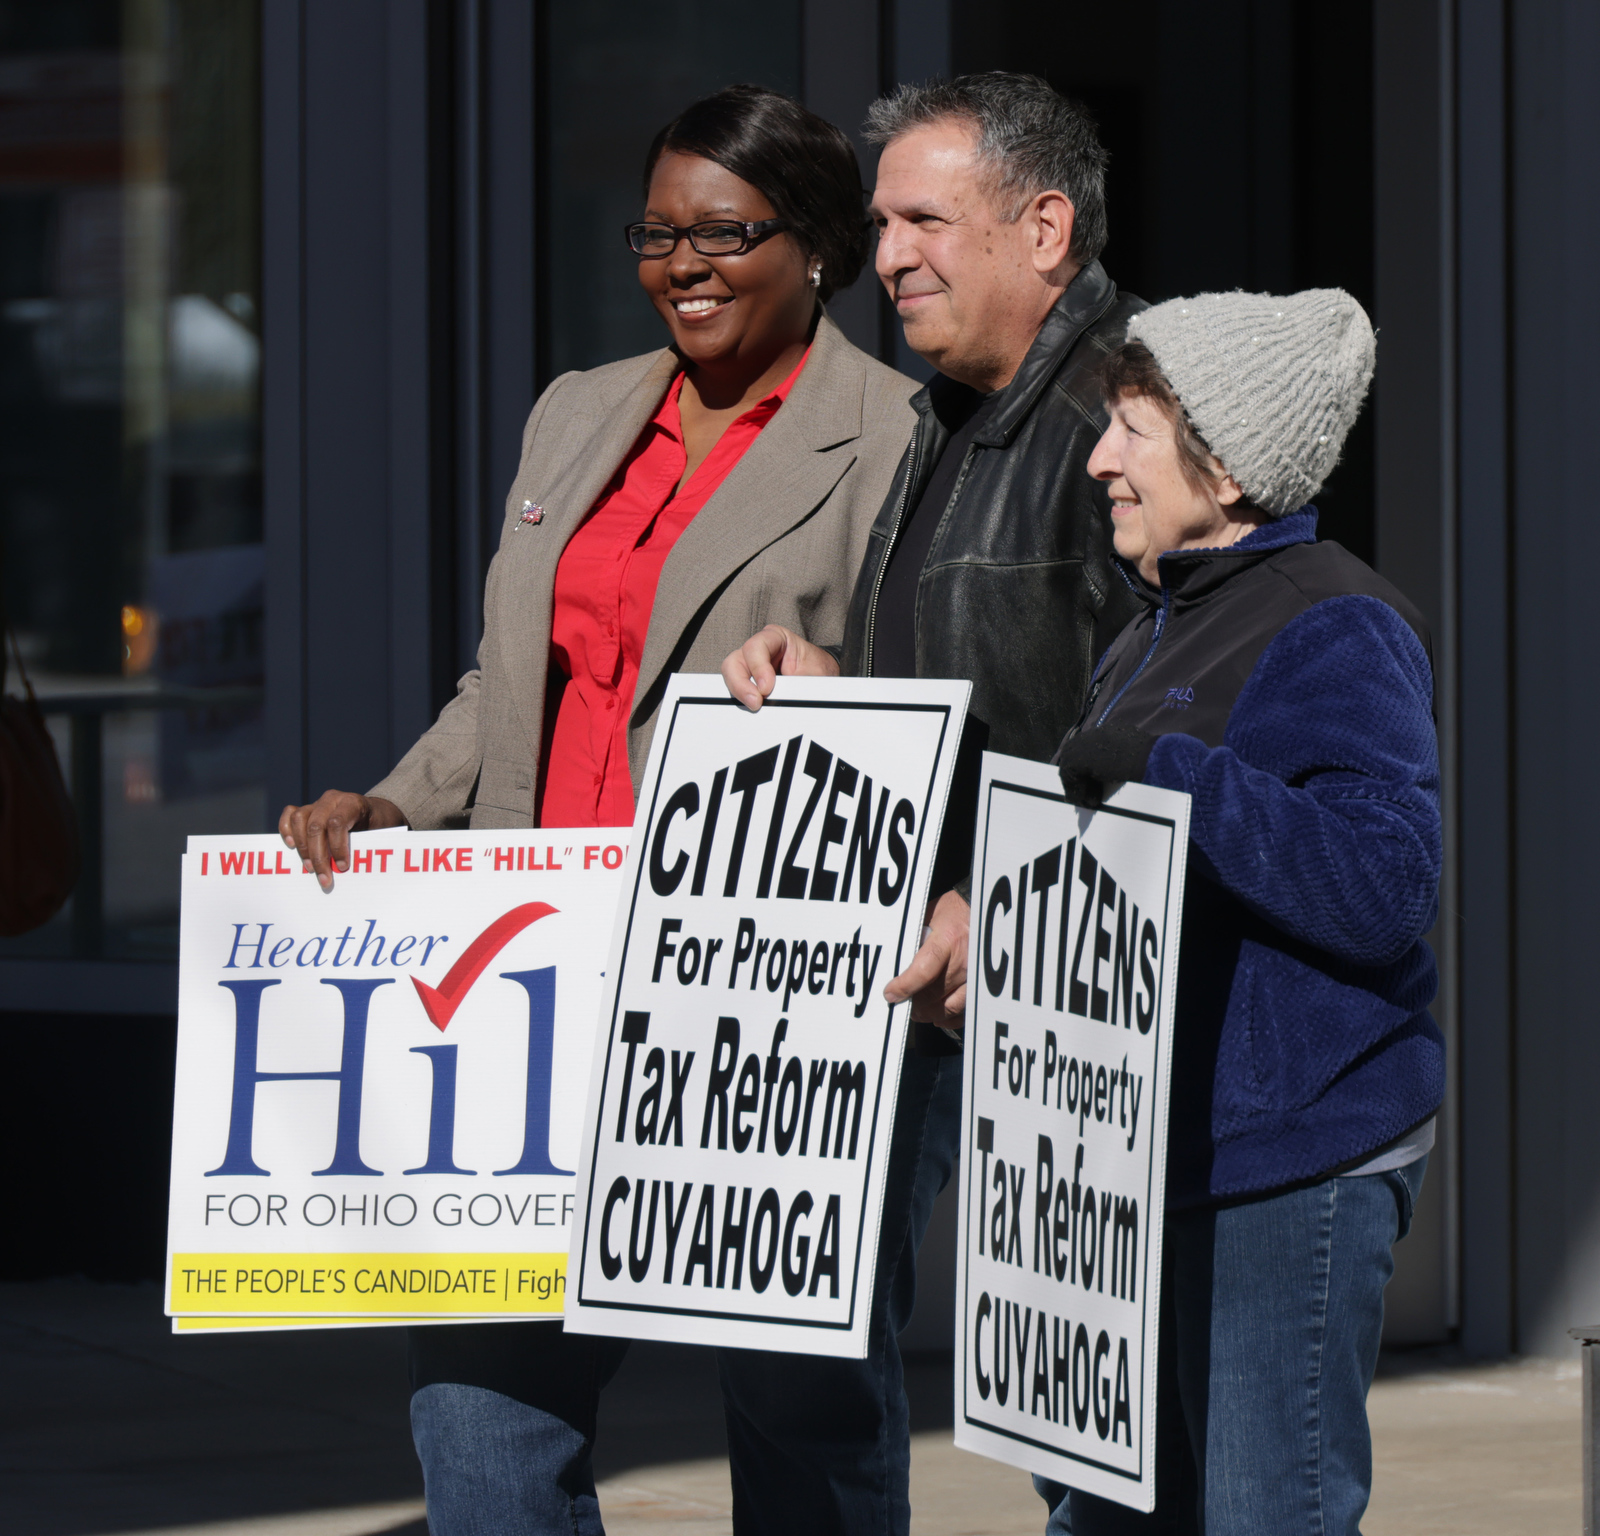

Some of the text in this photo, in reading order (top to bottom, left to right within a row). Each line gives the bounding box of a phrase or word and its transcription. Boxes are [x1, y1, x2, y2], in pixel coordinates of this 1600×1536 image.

[1164, 686, 1194, 702] FILA
[201, 852, 209, 876] I
[219, 851, 292, 876] WILL
[404, 848, 474, 872] LIKE
[483, 846, 574, 872] “HILL”
[583, 844, 629, 870] FO
[649, 734, 916, 907] CITIZENS
[222, 919, 449, 969] Heather
[651, 917, 883, 1019] For Property
[983, 835, 1158, 1036] CITIZENS
[203, 965, 606, 1177] Hil
[615, 1010, 867, 1160] Tax Reform
[993, 1020, 1143, 1152] For Property
[204, 1193, 288, 1227] FOR
[302, 1193, 418, 1227] OHIO
[599, 1175, 841, 1299] CUYAHOGA
[976, 1115, 1139, 1303] Tax Reform
[182, 1269, 227, 1293] THE
[235, 1268, 346, 1294] PEOPLE’S
[354, 1268, 497, 1294] CANDIDATE
[974, 1291, 1132, 1448] CUYAHOGA
